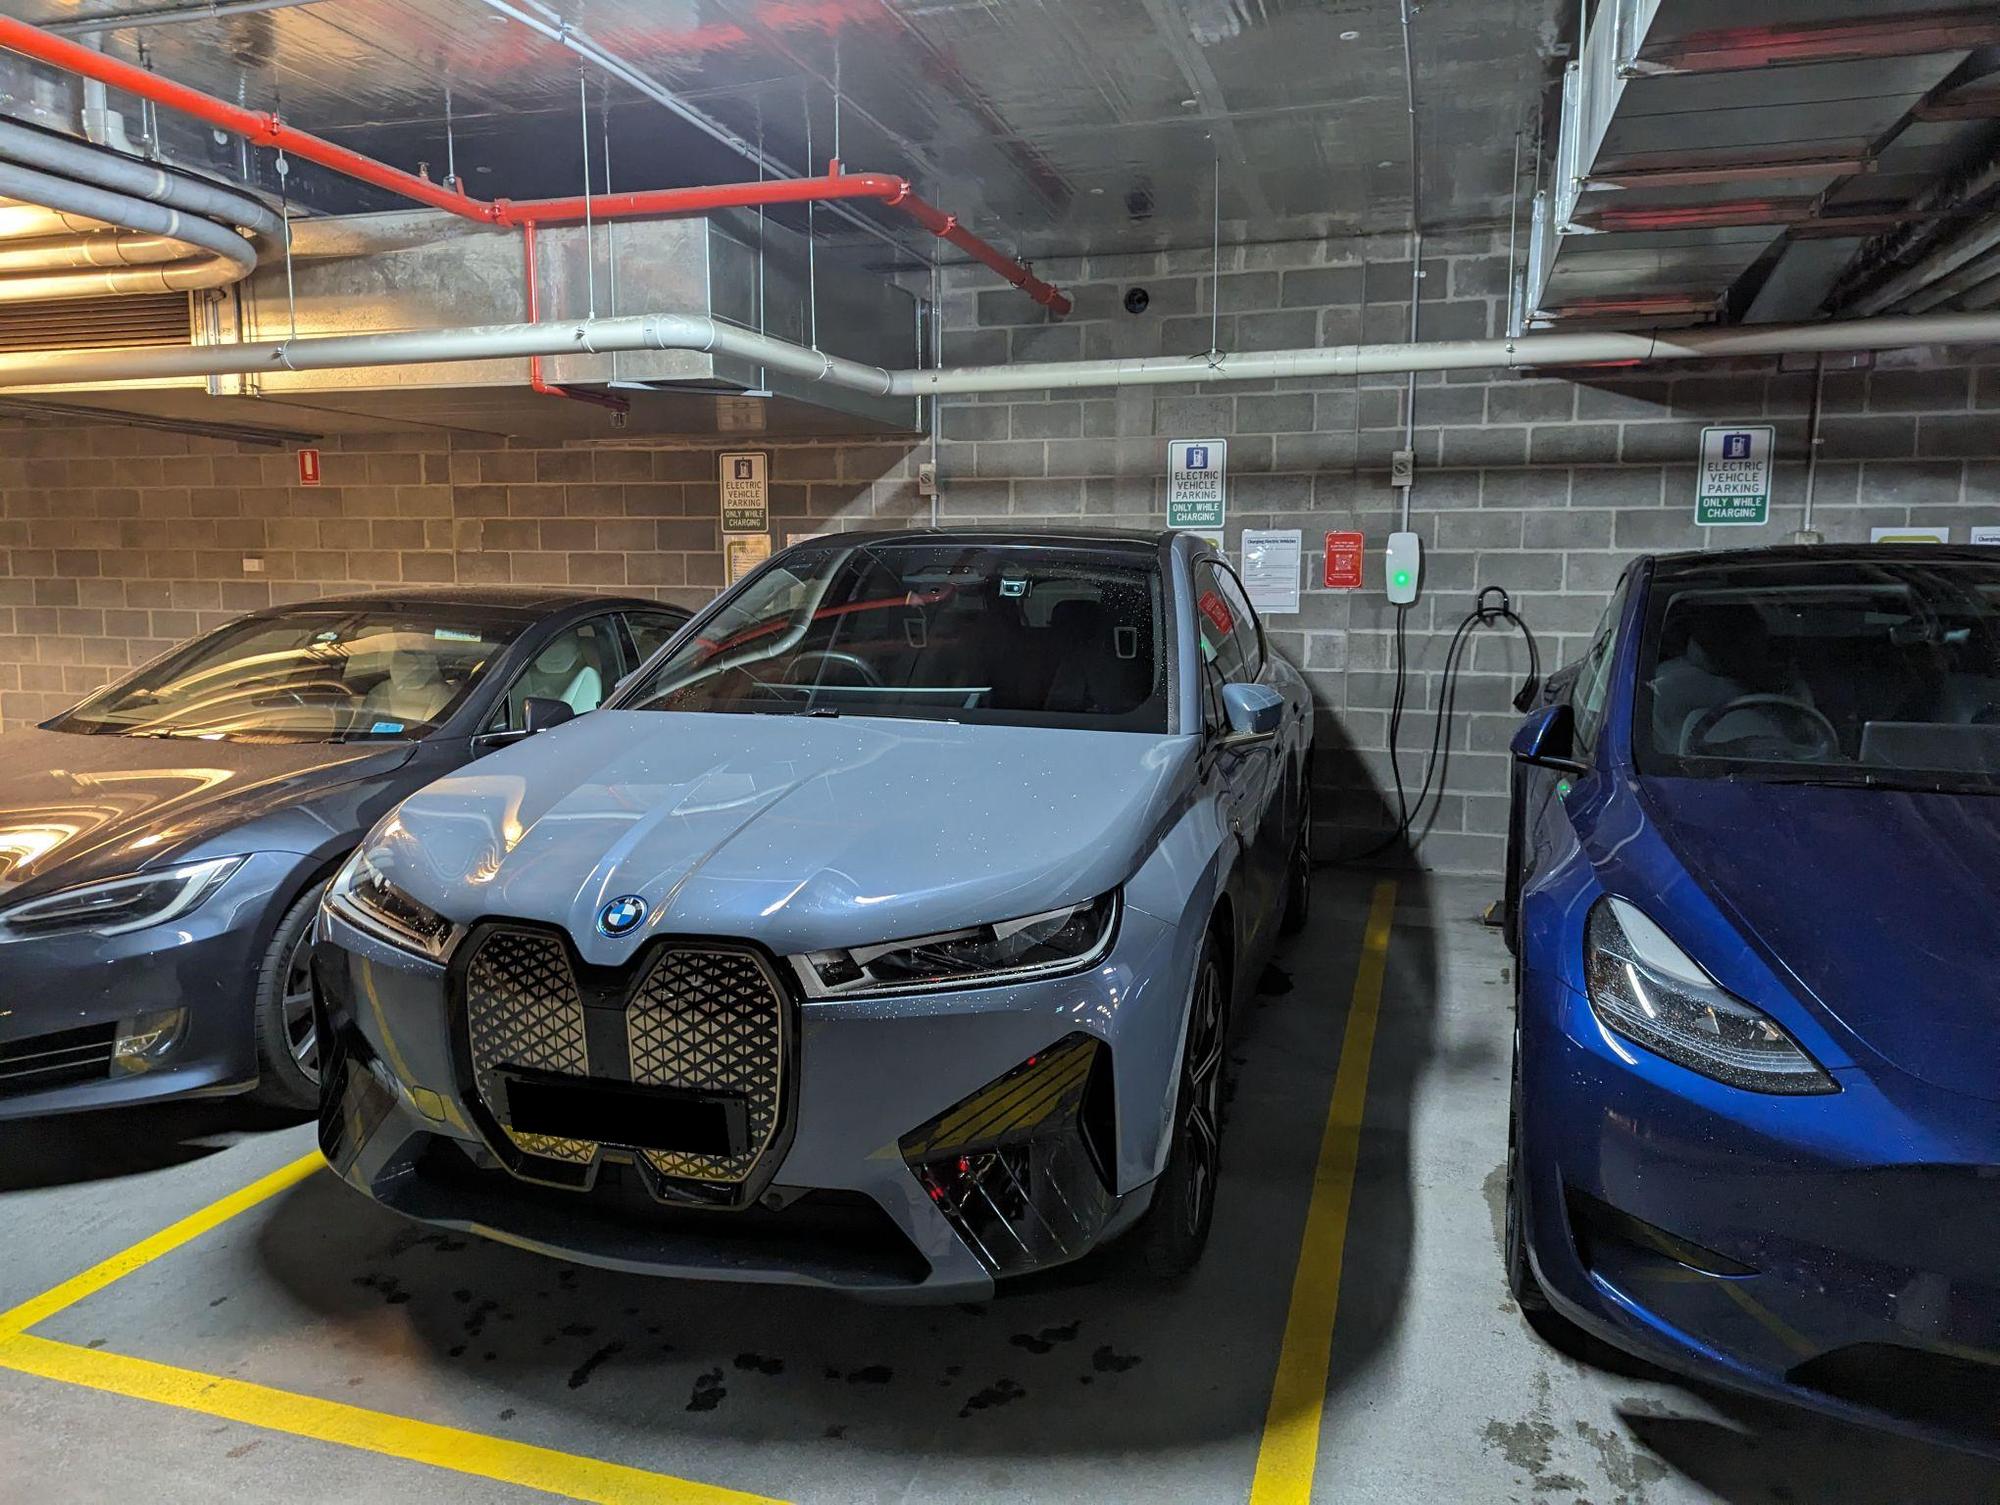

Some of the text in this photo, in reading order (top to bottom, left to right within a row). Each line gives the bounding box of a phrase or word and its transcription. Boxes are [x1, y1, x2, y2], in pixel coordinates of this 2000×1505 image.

[1707, 462, 1763, 472] ELECTRIC
[1175, 471, 1219, 480] ELECTRIC
[1710, 472, 1759, 482] VEHICLE
[725, 481, 762, 490] ELECTRIC
[1177, 480, 1216, 490] VEHICLE
[1707, 483, 1759, 493] PARKING
[728, 490, 760, 498] VEHICLE
[1175, 490, 1217, 500] PARKING
[727, 499, 761, 507] PARKING
[1172, 502, 1220, 512] ONLY WHILE
[1703, 497, 1763, 507] ONLY WHILE
[725, 510, 764, 518] ONLY WHILE
[1176, 512, 1215, 522] CHARGING
[1707, 508, 1757, 518] CHARGING
[728, 518, 761, 527] CHARGING
